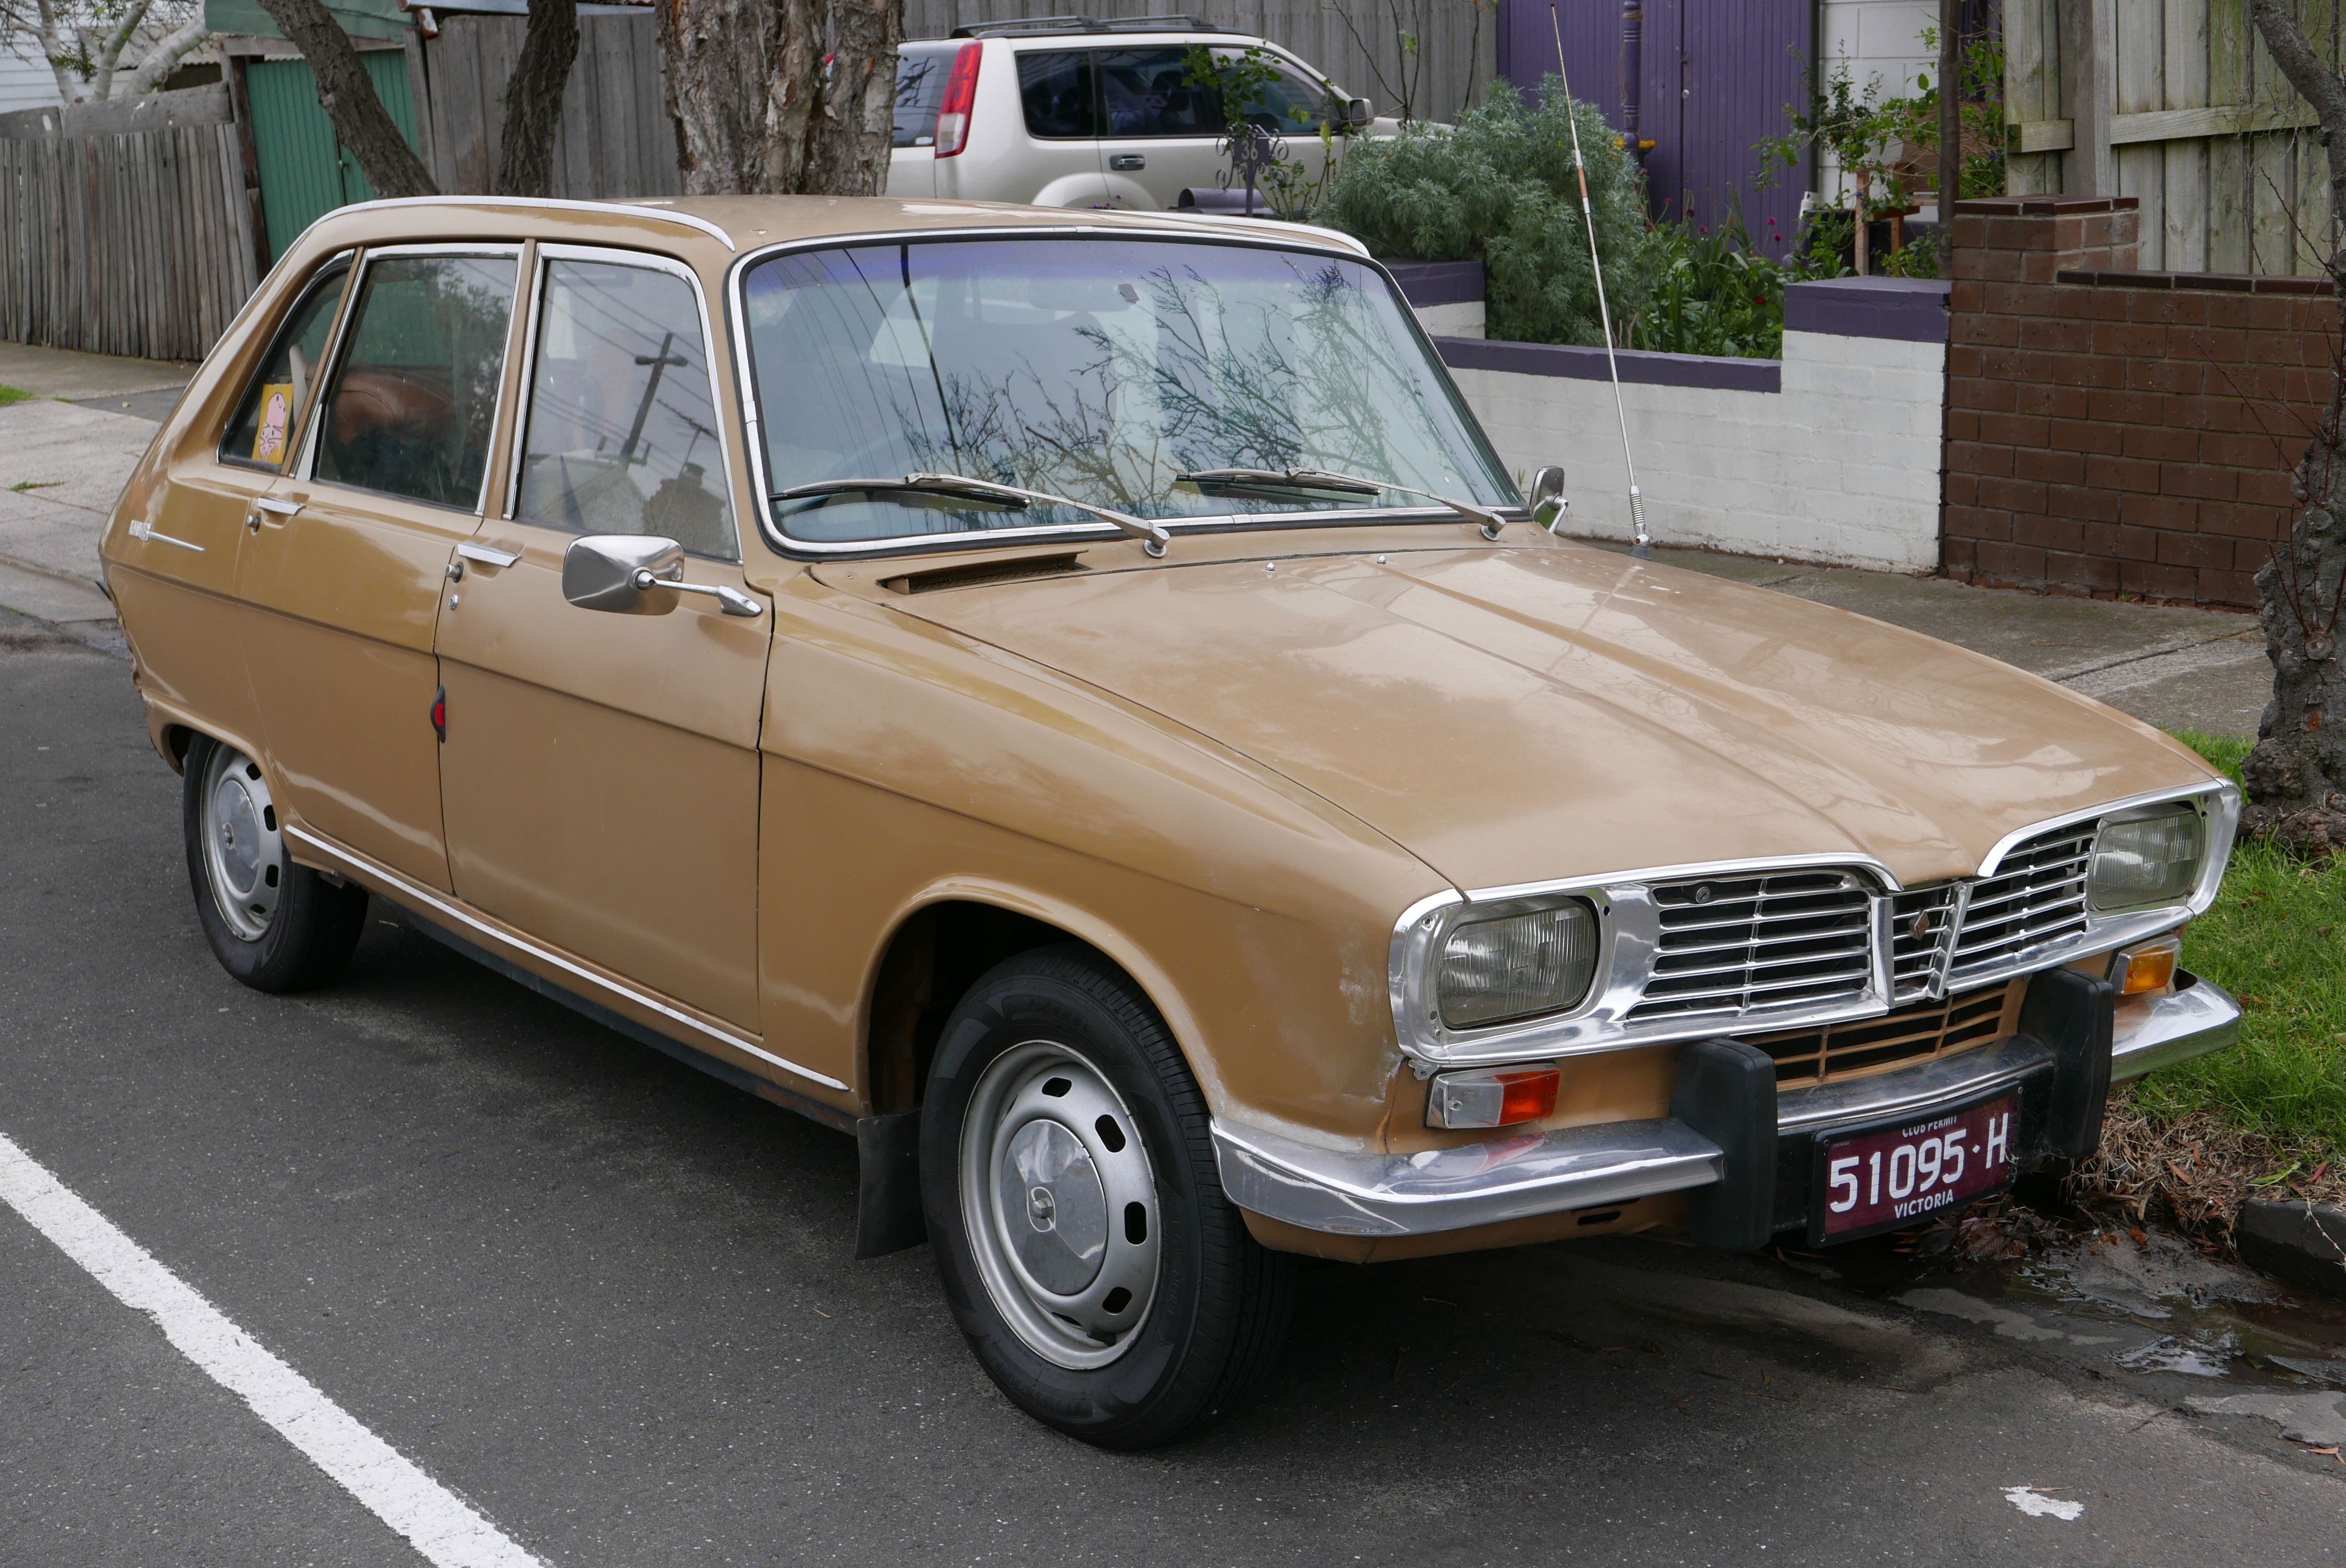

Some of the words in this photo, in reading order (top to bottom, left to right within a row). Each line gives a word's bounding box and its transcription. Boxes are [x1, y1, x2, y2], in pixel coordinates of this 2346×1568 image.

[1241, 139, 1259, 161] 36
[1902, 1124, 1926, 1138] CLUB
[1894, 1189, 1954, 1219] VICTORIA
